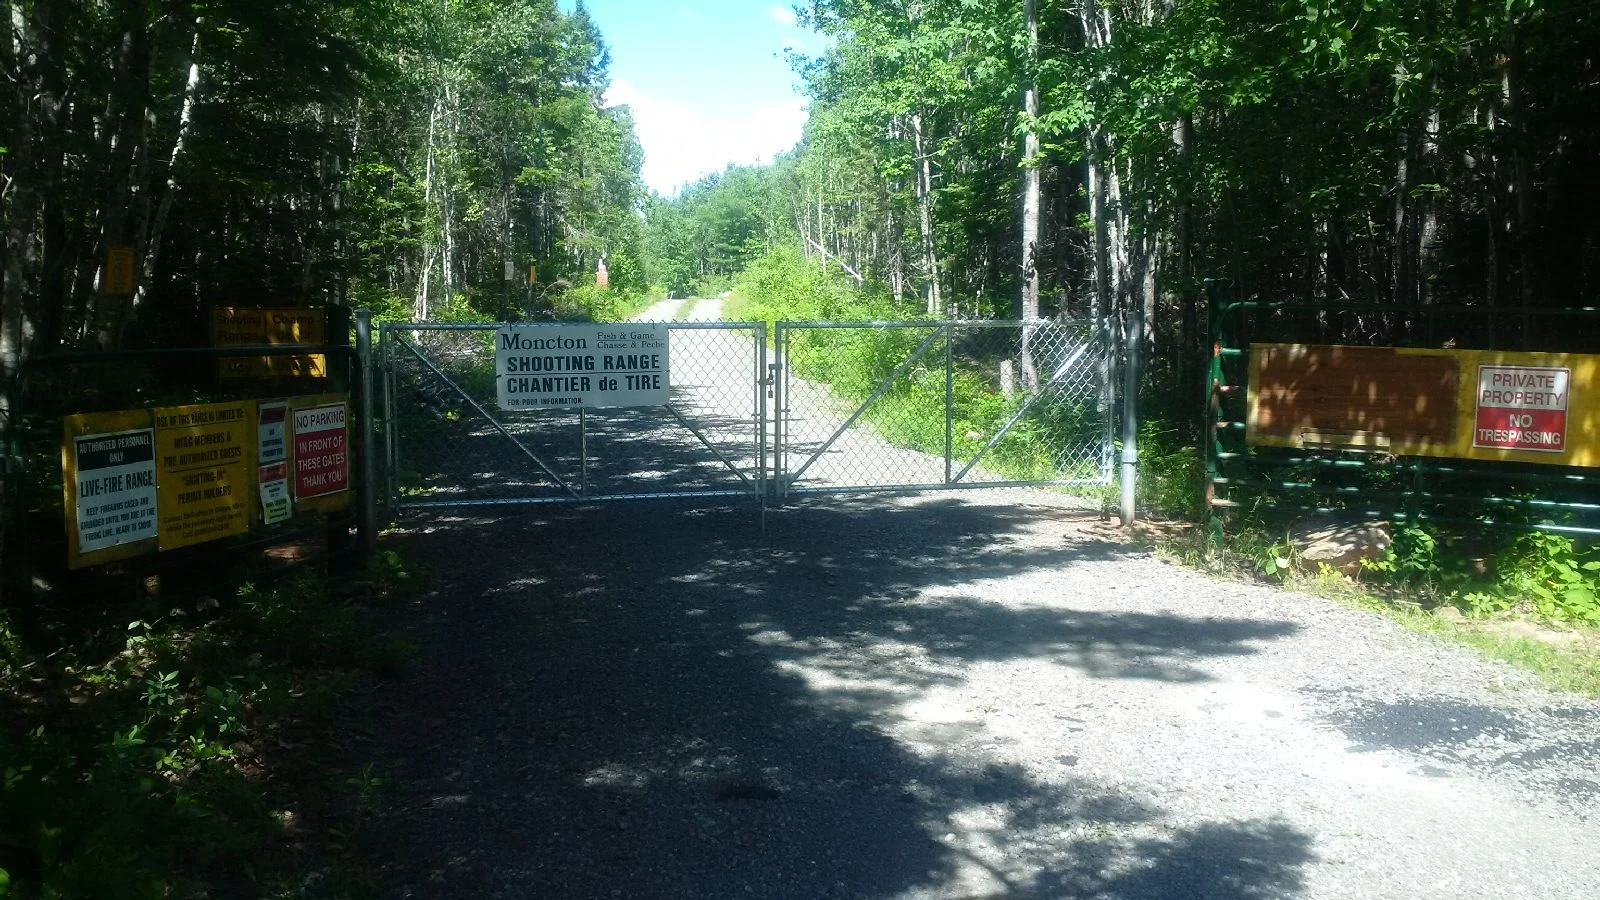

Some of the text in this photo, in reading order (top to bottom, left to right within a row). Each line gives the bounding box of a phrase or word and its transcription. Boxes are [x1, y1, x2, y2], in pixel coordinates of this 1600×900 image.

[501, 333, 587, 350] Moncton
[597, 332, 655, 340] Fish & Game
[597, 341, 627, 349] Chasse
[630, 341, 636, 349] &
[507, 354, 660, 372] SHOOTING RANGE
[507, 374, 661, 393] CHANTIER de TIRE
[1492, 373, 1555, 388] PRIVATE
[507, 398, 520, 406] FOR
[1482, 389, 1562, 406] PROPERTY
[156, 416, 169, 428] USE
[296, 415, 308, 429] NO
[310, 410, 344, 427] PARKING
[1509, 413, 1533, 428] NO
[79, 435, 150, 454] AUTHORIZED PERSONNEL
[299, 435, 342, 454] IN FRONT OF
[1478, 428, 1561, 445] TRESPASSING
[109, 452, 124, 463] ONLY
[298, 452, 345, 472] THESE GATES
[80, 475, 123, 498] LIVE-FIRE
[303, 473, 326, 489] THANK
[86, 506, 98, 517] KEEP
[100, 502, 124, 514] FIREARMS
